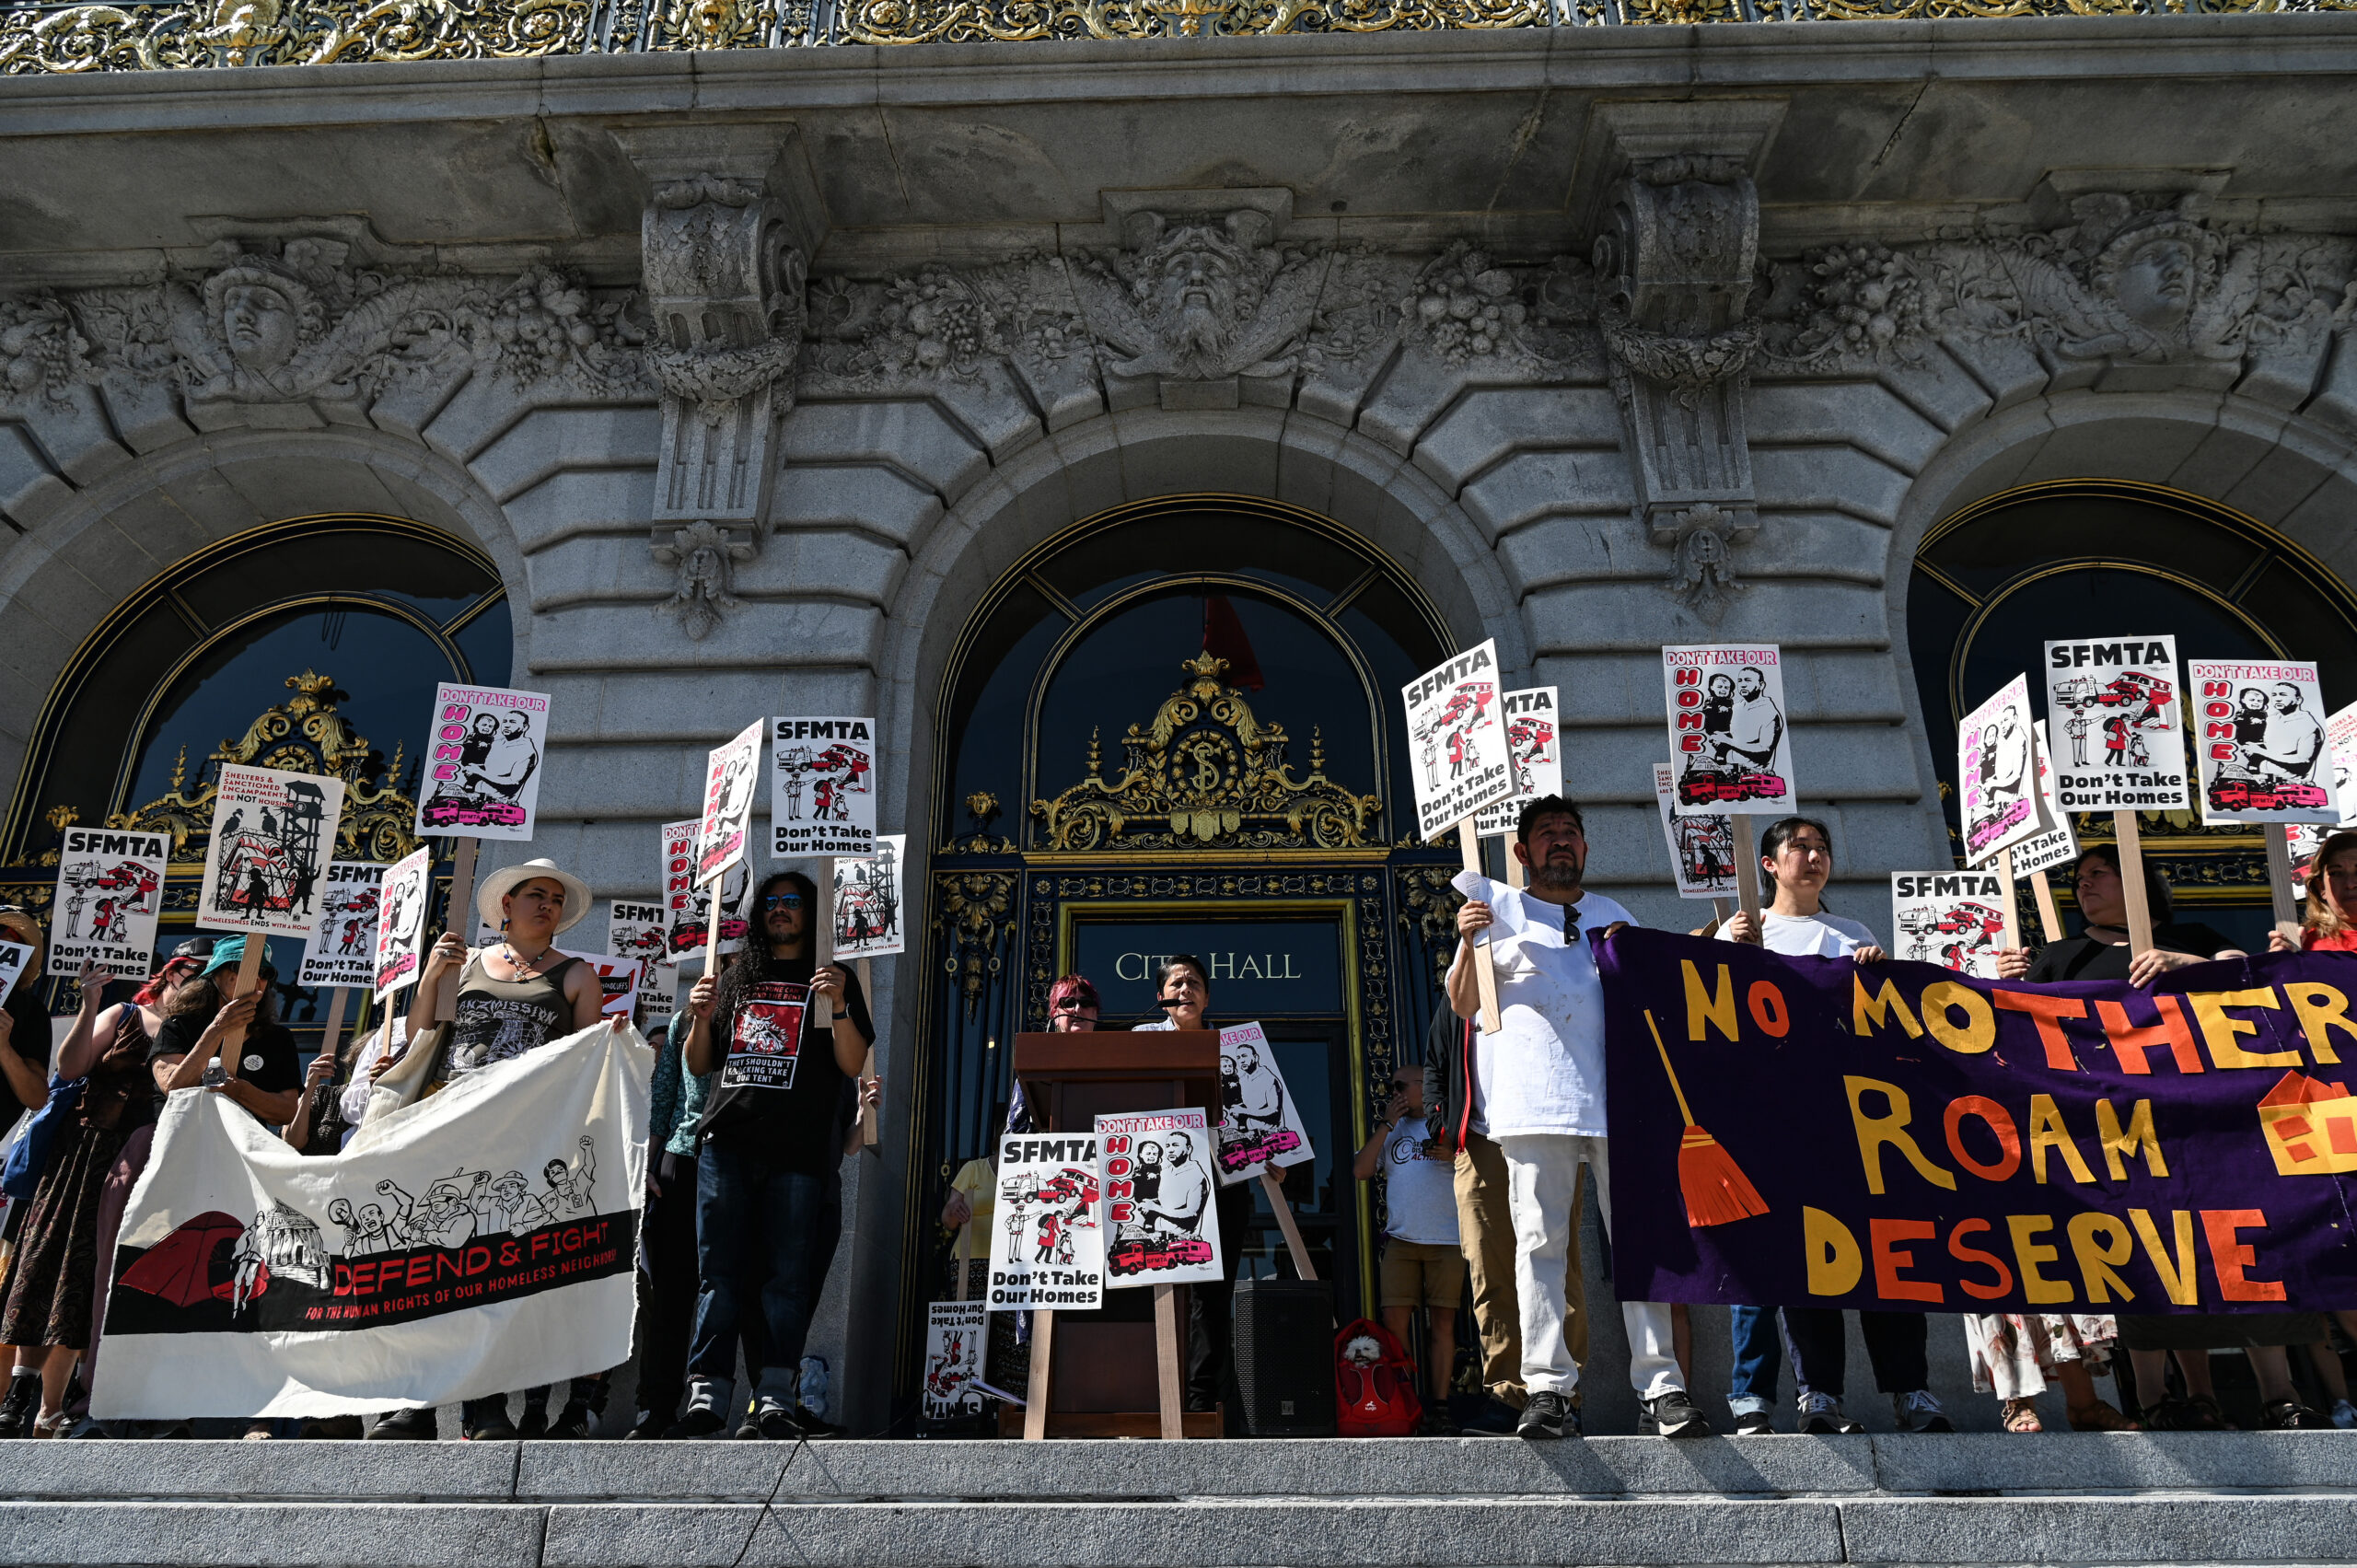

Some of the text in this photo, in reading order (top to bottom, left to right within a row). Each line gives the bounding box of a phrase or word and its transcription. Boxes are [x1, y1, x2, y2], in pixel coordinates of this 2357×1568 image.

[1666, 650, 1777, 666] DON'T TAKE OUR
[2051, 641, 2171, 668] SFMTA
[1408, 648, 1492, 710] SFMTA
[2193, 665, 2315, 682] DON'T TAKE OUR
[439, 689, 546, 712] DON'T TAKE OUR
[1505, 692, 1552, 714] MTA
[1674, 667, 1707, 755] HOME
[2201, 679, 2239, 762] HOME
[777, 721, 870, 740] SFMTA
[431, 703, 471, 783] HOME
[225, 772, 264, 783] SHELTERS
[1965, 727, 1981, 810] HOME
[224, 778, 280, 791] SANCTIONED
[2059, 772, 2182, 788] Don't Take
[223, 784, 287, 799] ENCAMPMENTS
[705, 761, 726, 834] HOME
[1422, 763, 1504, 818] Don't Take
[2061, 790, 2183, 807] Our Homes
[236, 795, 256, 804] NOT
[258, 798, 295, 808] HOUSING
[1423, 779, 1507, 831] Our Homes
[1478, 801, 1514, 816] on't
[775, 825, 871, 839] Don't Take
[2031, 831, 2067, 851] Take
[68, 832, 163, 858] SFMTA
[775, 840, 871, 853] Our Homes
[2020, 845, 2070, 871] Homes
[326, 865, 388, 884] SFMT
[668, 839, 691, 912] HOME
[1897, 877, 2002, 898] SFMTA
[203, 915, 249, 926] HOMELESSNESS
[250, 919, 270, 928] ENDS
[378, 882, 395, 954] HOME
[613, 904, 664, 923] SFMT
[53, 945, 148, 961] Don't Take
[52, 958, 81, 971] Our
[306, 958, 375, 971] Don't Tak
[1209, 952, 1302, 980] HALL
[302, 971, 329, 981] Our
[642, 993, 672, 1004] Take
[1681, 959, 1790, 1042] NO
[1220, 1028, 1262, 1046] AKE OUR
[737, 1074, 751, 1083] OUR
[768, 1068, 788, 1076] TAKE
[1097, 1112, 1204, 1134] DON'T TAKE OUR
[1841, 1075, 2169, 1196] ROAM
[1105, 1134, 1136, 1224] HOME
[333, 1221, 610, 1296] DEFEND & FIGHT
[1803, 1205, 2287, 1307] DESERVE
[993, 1271, 1098, 1287] Don't Take
[306, 1306, 323, 1320] FOR
[326, 1305, 343, 1318] THE
[343, 1302, 379, 1318] HUMAN
[383, 1293, 429, 1314] RIGHTS
[435, 1289, 450, 1304] OF
[455, 1283, 482, 1300] OUR
[488, 1265, 556, 1293] HOMELESS
[991, 1288, 1097, 1304] Our Homes
[932, 1304, 983, 1315] Our Homes
[931, 1317, 956, 1328] Take
